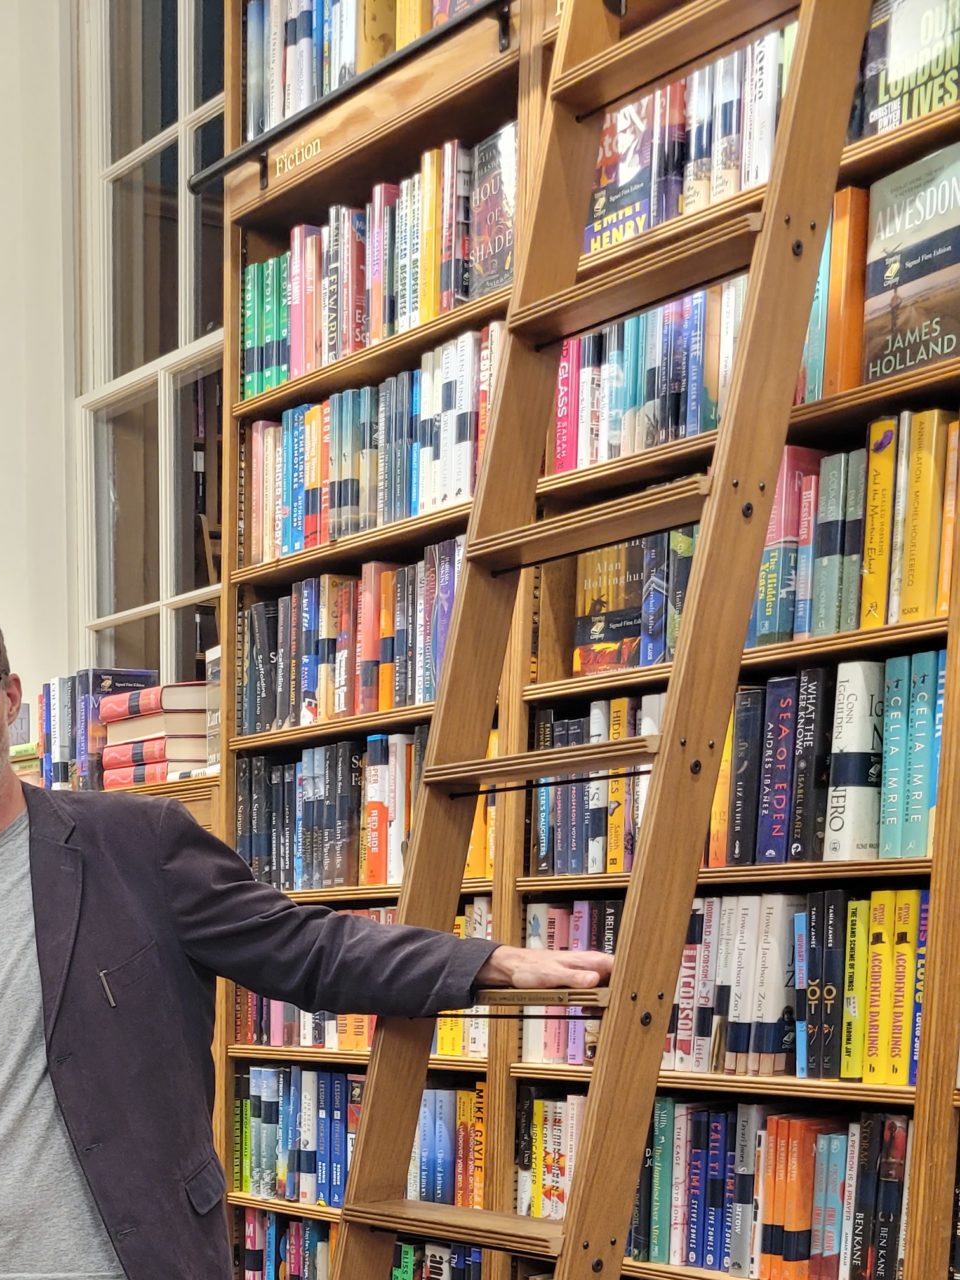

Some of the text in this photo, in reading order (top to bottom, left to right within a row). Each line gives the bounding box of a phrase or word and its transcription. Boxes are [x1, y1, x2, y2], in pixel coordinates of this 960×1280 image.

[901, 69, 958, 125] LIVES
[274, 138, 321, 177] Fiction
[590, 216, 649, 252] HENRY
[875, 177, 960, 242] ALVESDON
[868, 334, 957, 380] HOLLAND
[884, 317, 941, 354] JAMES
[558, 362, 569, 418] GLASS
[915, 420, 926, 485] ANNIHILATION
[596, 561, 621, 573] Alan
[796, 711, 806, 755] KNOWS
[803, 681, 818, 748] WHAT THE
[834, 679, 849, 740] IGGULDEN
[772, 697, 792, 836] SEA OF EDEN
[886, 696, 902, 826] CELIA IMRIE
[909, 692, 928, 824] CELIA IMRIE
[829, 786, 847, 833] NERO
[867, 951, 882, 1057] ACCIDENTAL DARLINGS
[891, 951, 907, 1057] ACCIDENTAL DARLINGS
[473, 1088, 484, 1173] MIKE GAYLE
[709, 1122, 721, 1160] CALL
[691, 1160, 702, 1195] TIME
[852, 1211, 864, 1266] BEN KANE
[876, 1226, 888, 1277] BEN KANE
